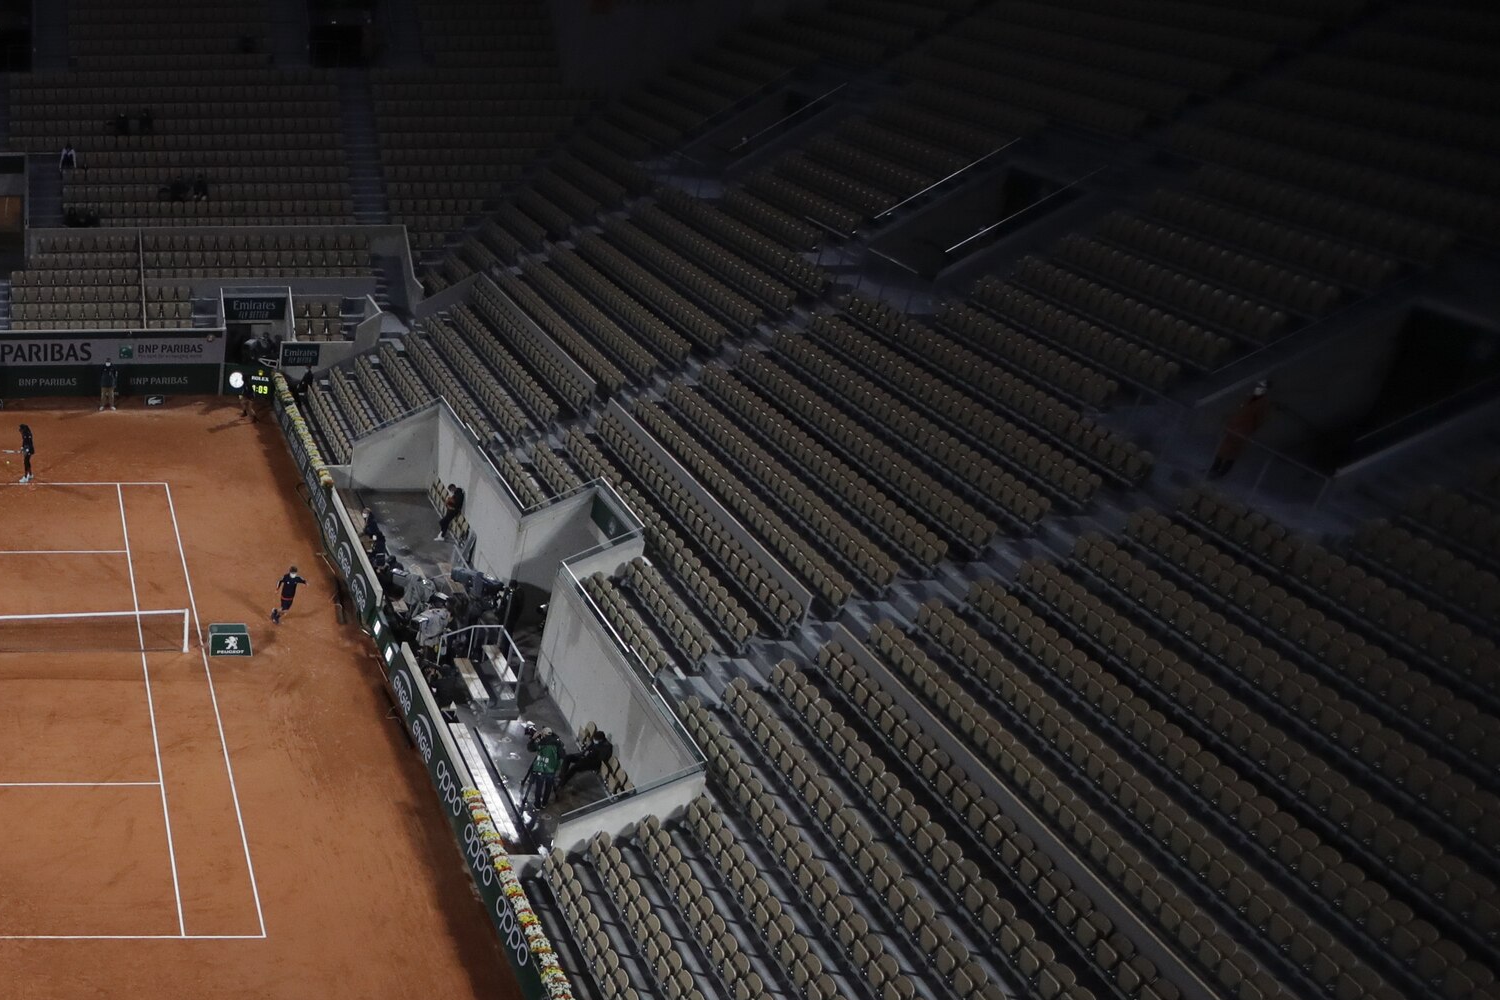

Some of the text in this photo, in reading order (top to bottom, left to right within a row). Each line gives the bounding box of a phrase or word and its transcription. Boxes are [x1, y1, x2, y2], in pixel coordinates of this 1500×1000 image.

[233, 300, 276, 310] Emirates
[0, 343, 92, 362] PARIBAS
[138, 344, 203, 353] BNP PARIBAS
[284, 349, 317, 357] Emirates
[18, 378, 77, 386] BNP PARIBAS
[130, 376, 188, 385] BNP PARIBAS
